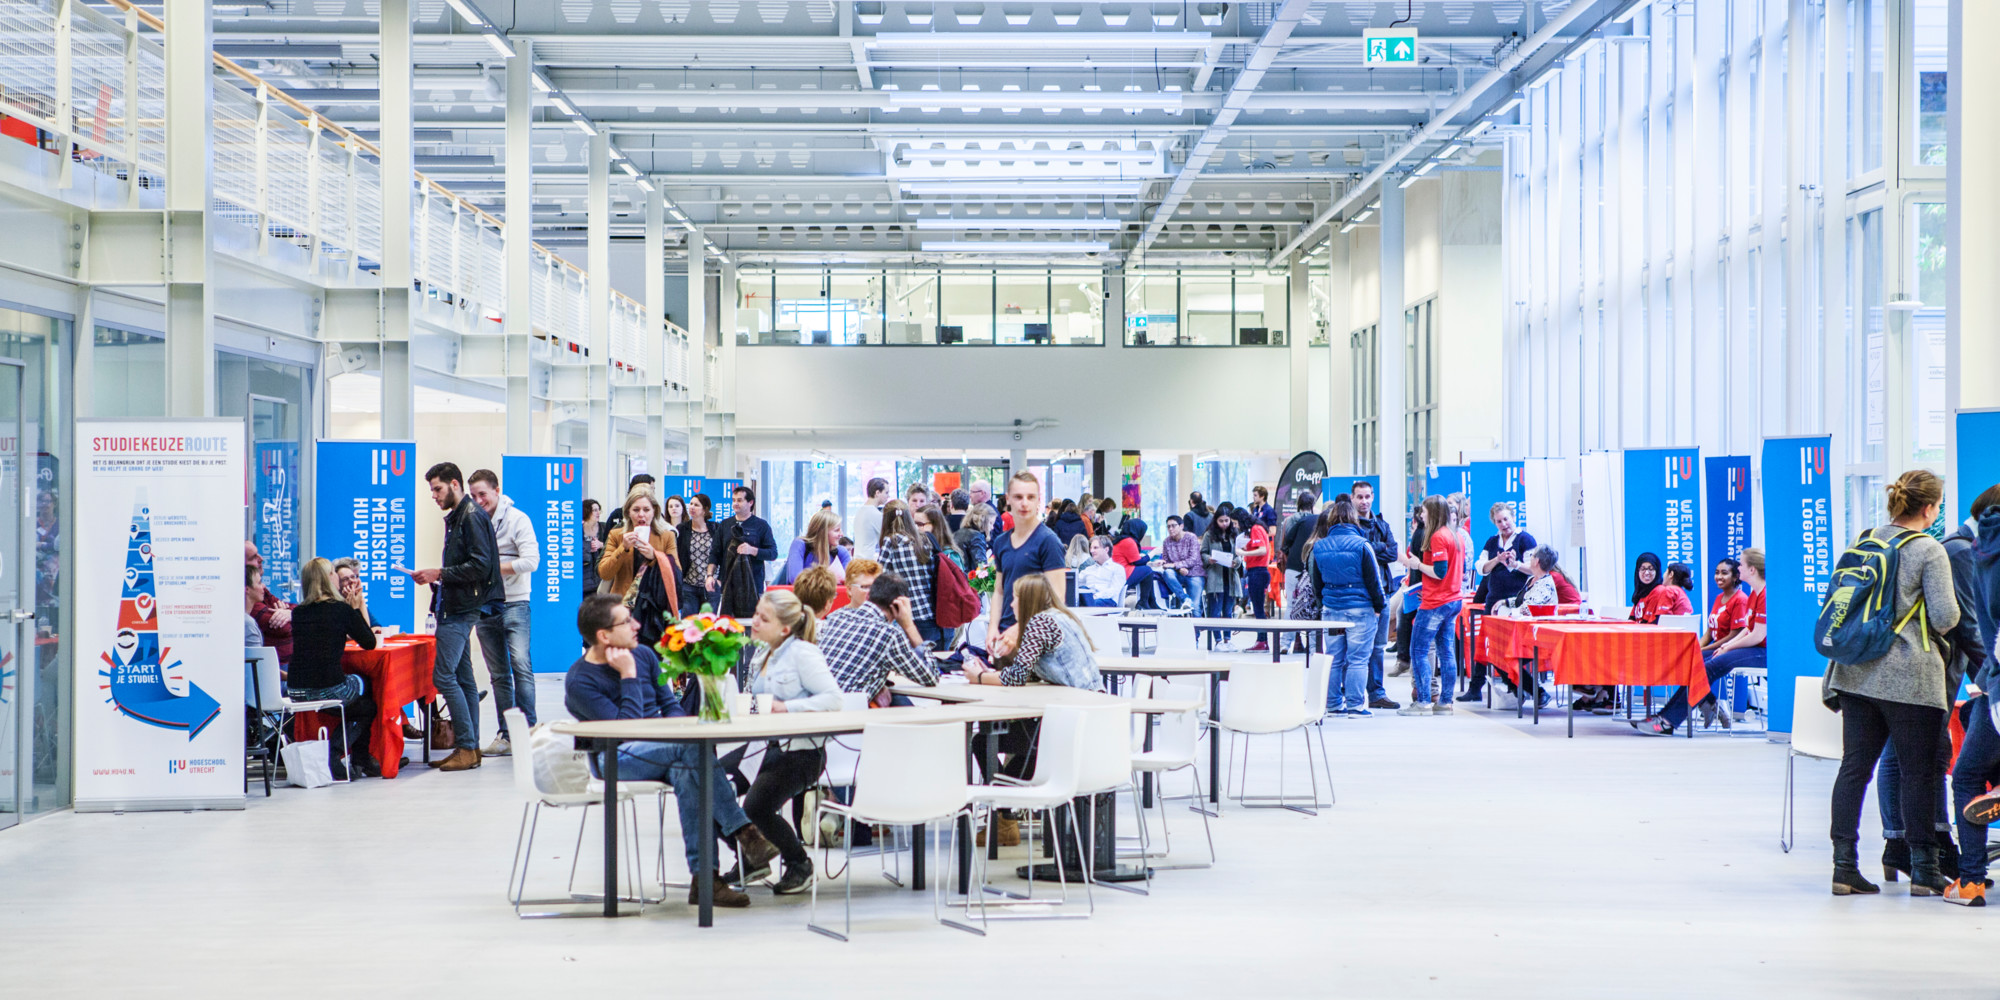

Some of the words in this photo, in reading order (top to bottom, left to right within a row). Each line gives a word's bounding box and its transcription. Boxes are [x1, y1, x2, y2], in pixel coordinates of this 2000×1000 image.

[93, 437, 227, 451] STUDIEKEUZEROUTE
[371, 498, 387, 581] MEDISCHE
[562, 501, 574, 556] WELKOM
[1681, 500, 1694, 564] WELKOM
[1802, 499, 1815, 592] LOGOPEDIE
[1816, 498, 1829, 575] WELKOM
[547, 501, 559, 602] MEELOOPDAGEN
[562, 561, 574, 579] BIJ
[390, 575, 405, 599] BIJ
[1834, 602, 1849, 629] FACE
[116, 675, 124, 683] JE
[128, 675, 158, 683] STUDIE!
[118, 665, 155, 674] START
